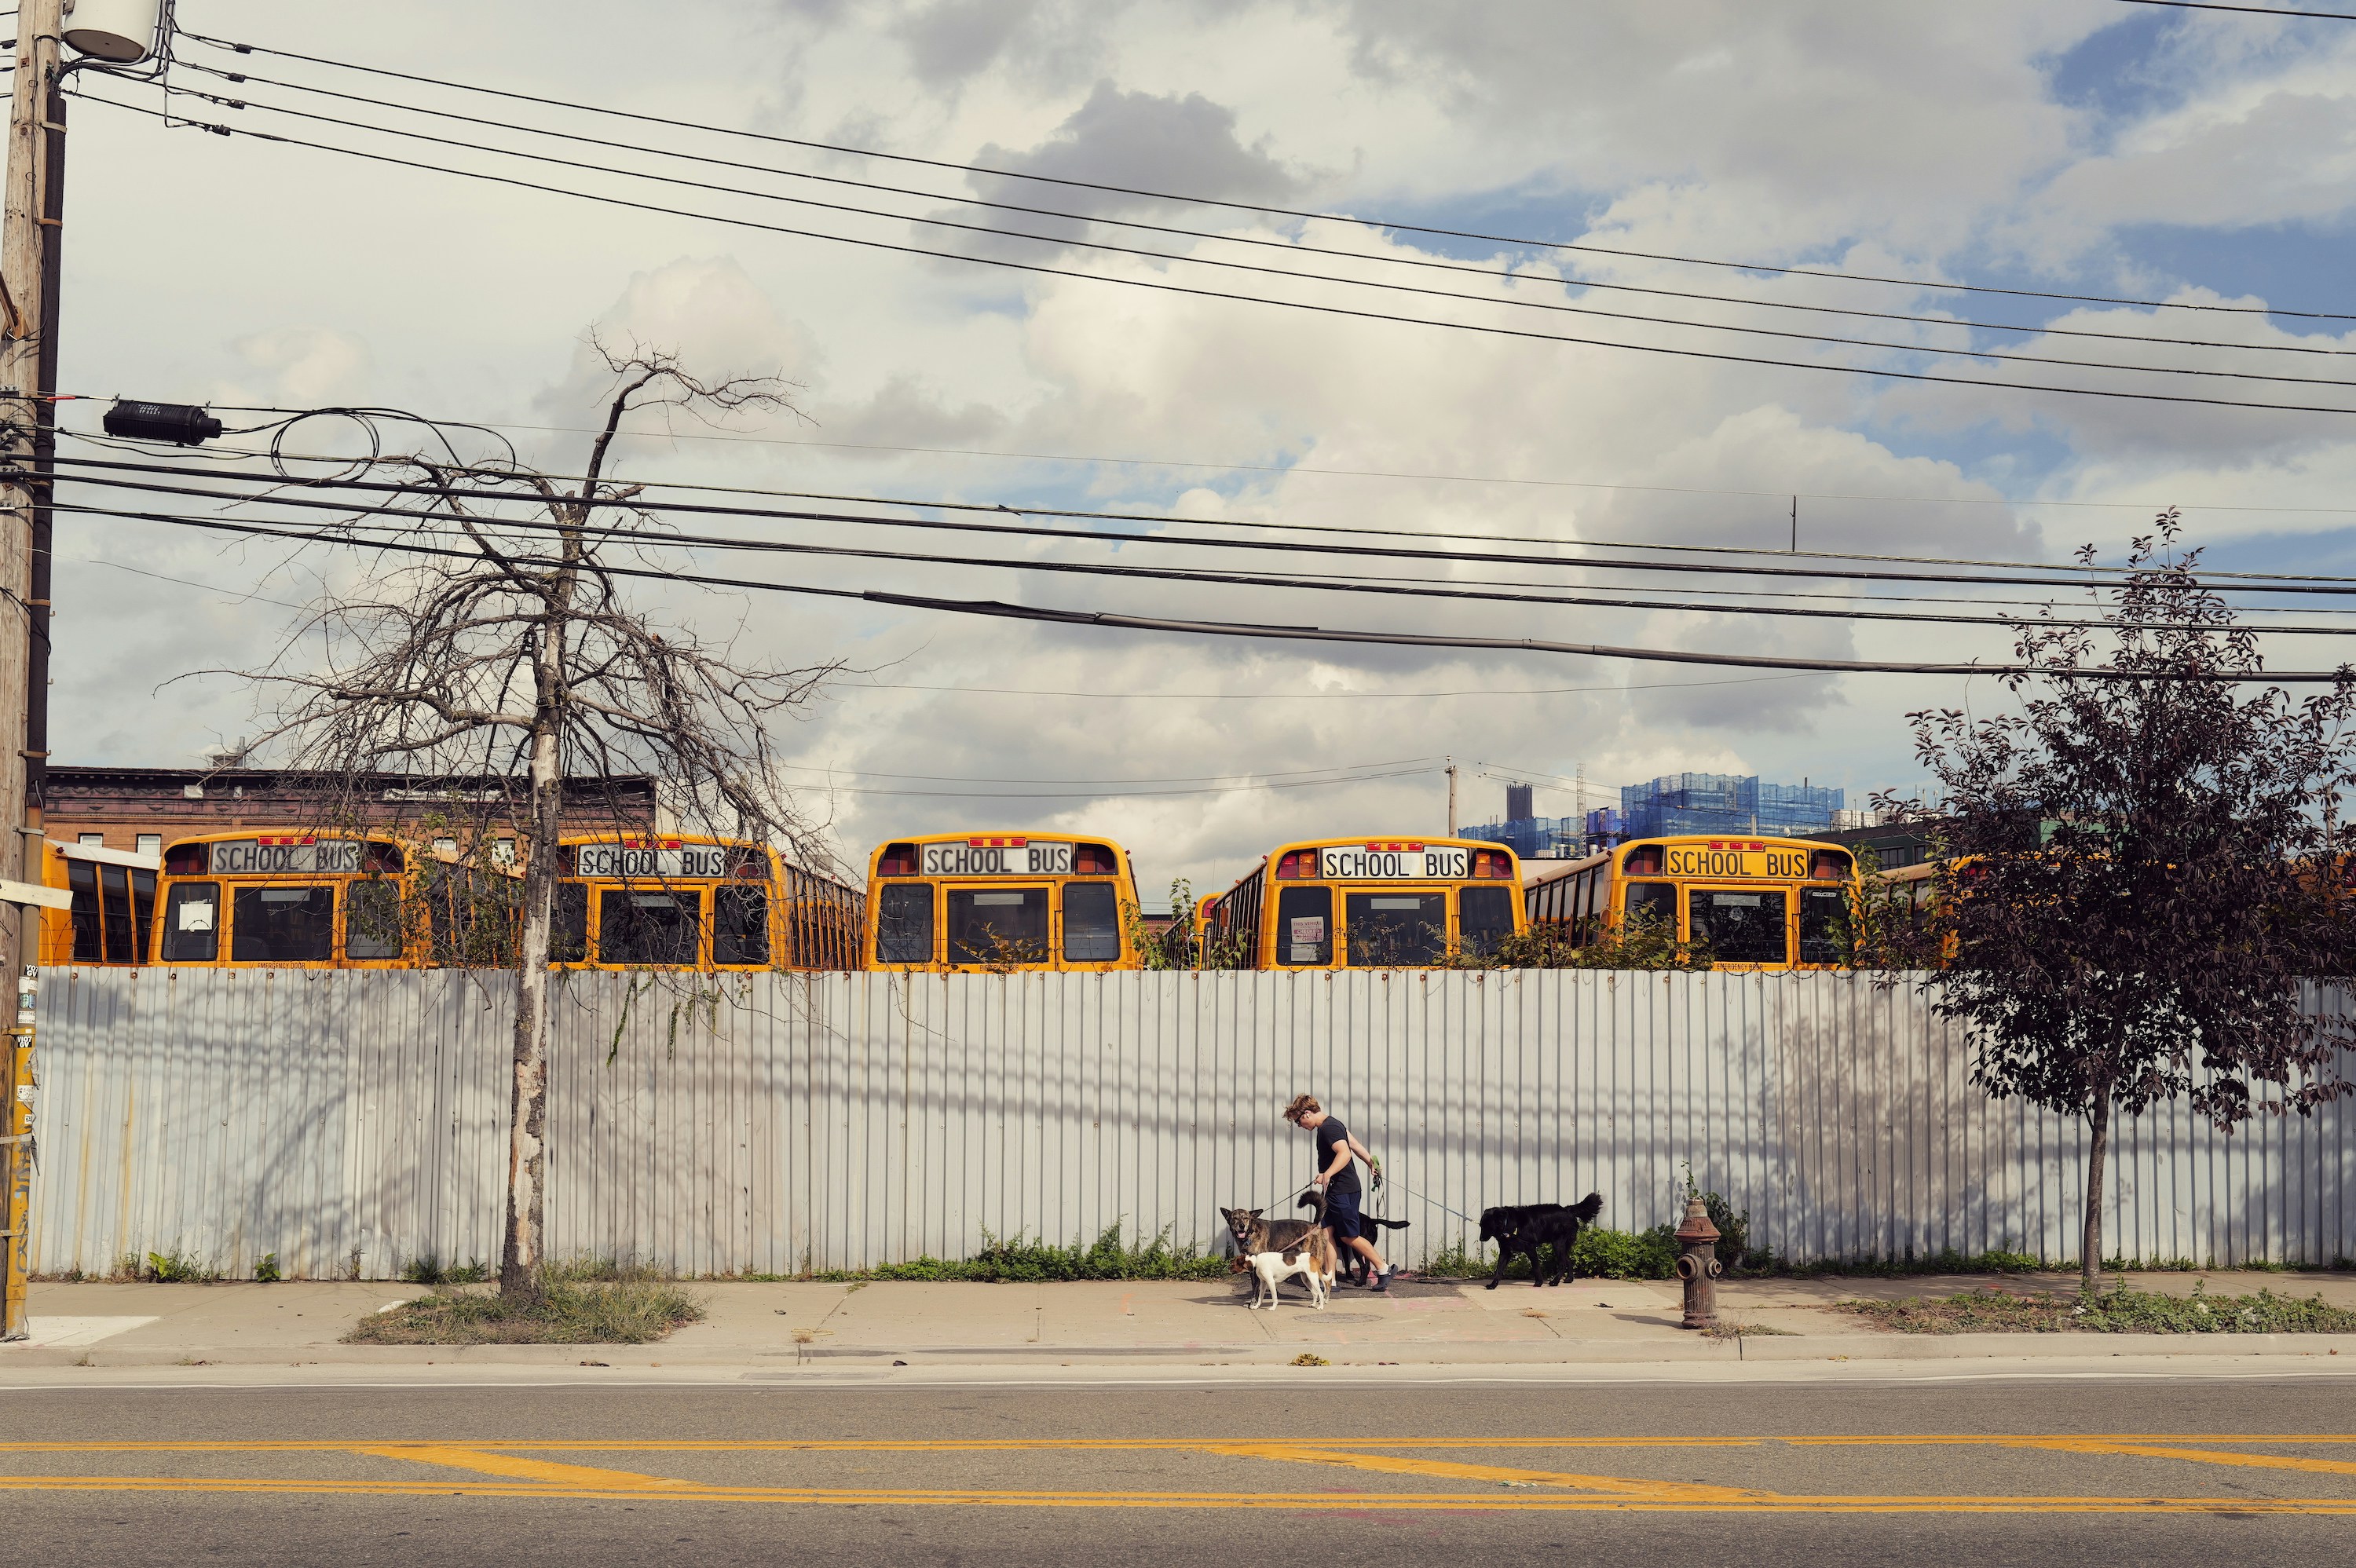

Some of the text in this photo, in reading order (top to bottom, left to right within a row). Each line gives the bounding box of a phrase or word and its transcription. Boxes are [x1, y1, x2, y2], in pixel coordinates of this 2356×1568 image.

[215, 846, 353, 871] SCHOOL BUS
[582, 850, 722, 875] SCHOOL BUS
[927, 848, 1069, 872] SCHOOL BUS
[1326, 853, 1465, 877] SCHOOL BUS
[1670, 850, 1805, 877] SCHOOL BUS
